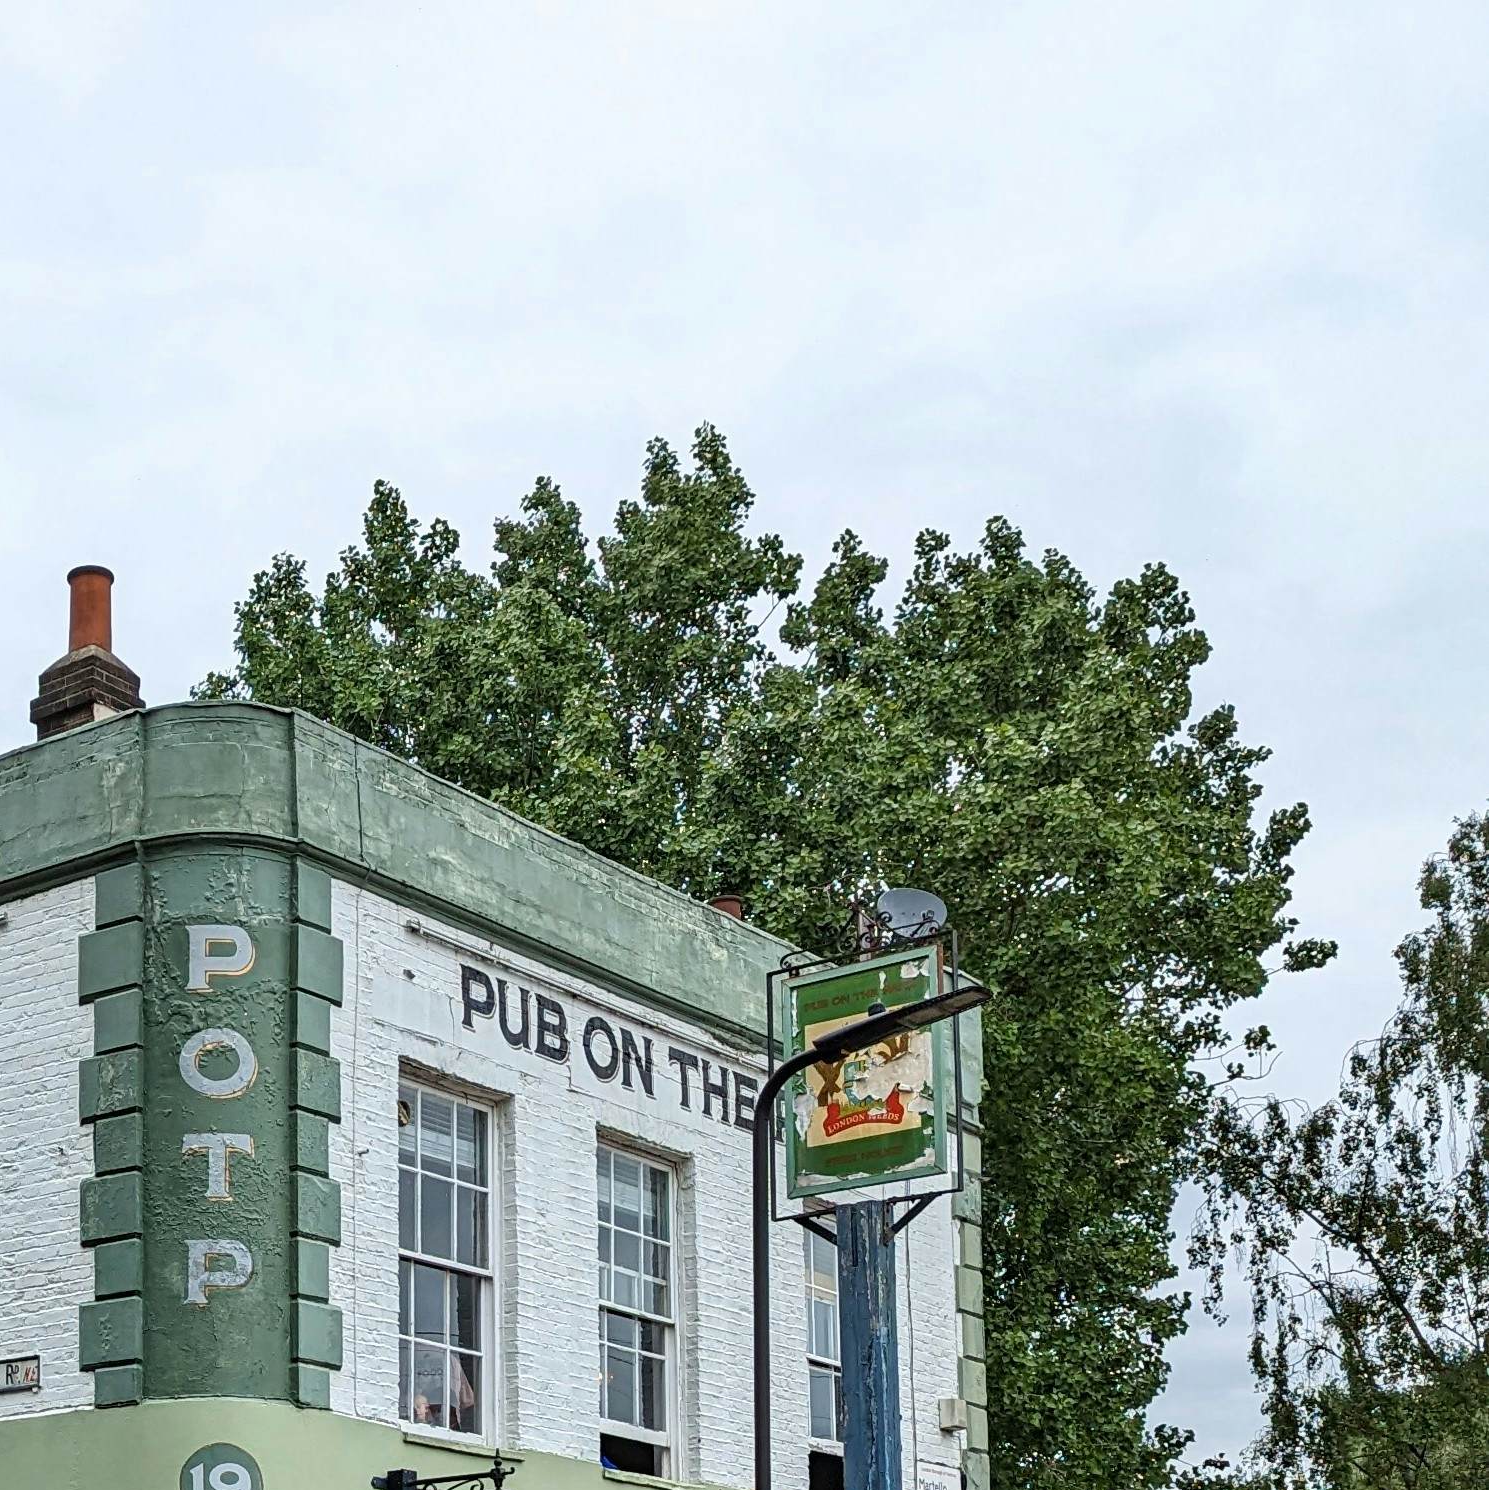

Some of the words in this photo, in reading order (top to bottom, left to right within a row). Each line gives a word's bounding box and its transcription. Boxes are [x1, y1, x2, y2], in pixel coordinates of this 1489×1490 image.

[179, 924, 258, 1307] POTP
[459, 963, 571, 1065] PUB
[582, 1016, 656, 1099] ON
[668, 1046, 759, 1131] THE
[827, 1113, 865, 1133] LONDON
